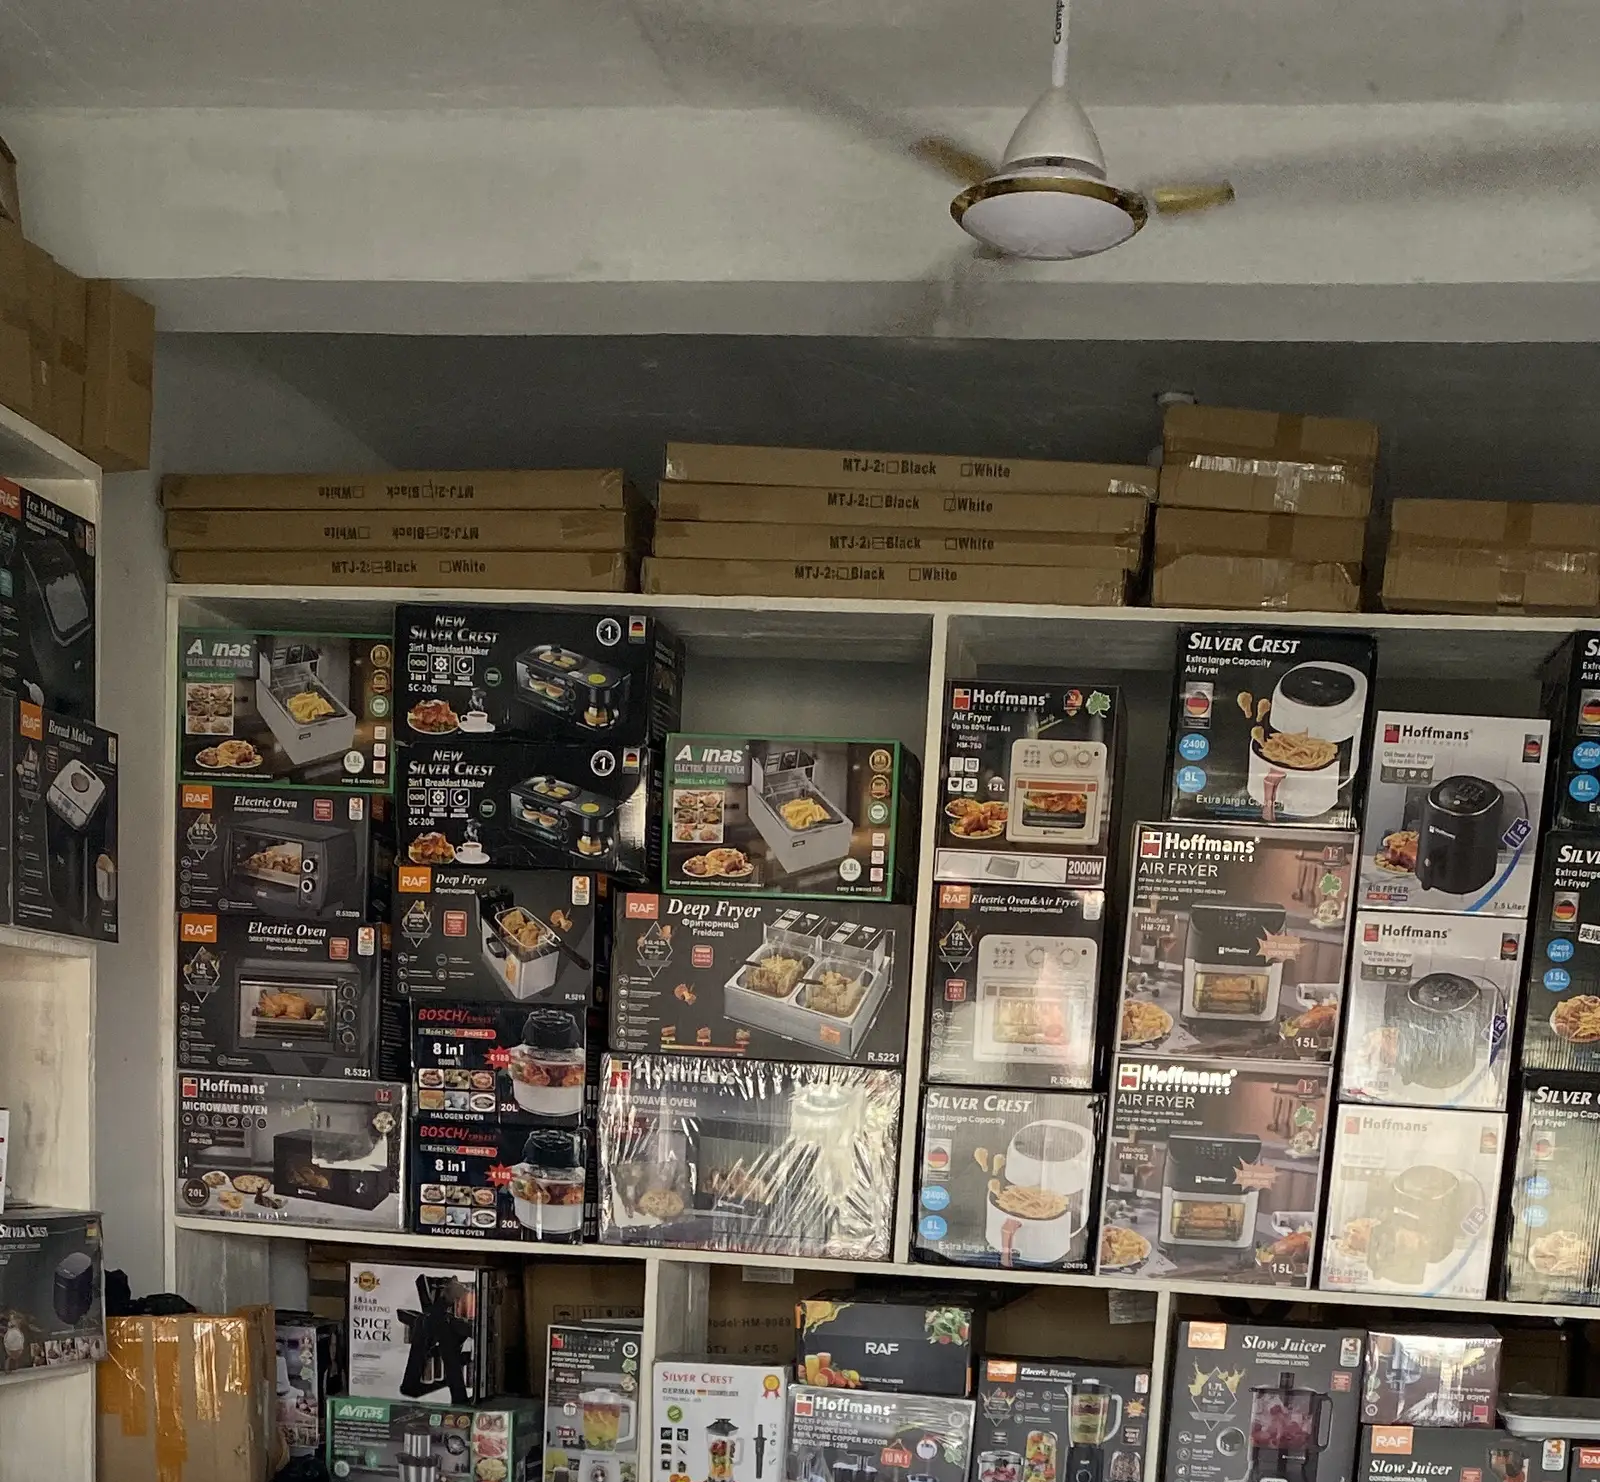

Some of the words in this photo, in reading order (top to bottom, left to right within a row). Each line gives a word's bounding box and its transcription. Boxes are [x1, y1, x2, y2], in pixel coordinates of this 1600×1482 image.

[900, 460, 936, 476] Black
[973, 463, 1010, 478] White
[383, 560, 418, 574] Black
[451, 560, 486, 574] White
[435, 615, 466, 627] NEW
[409, 625, 452, 642] SILVER
[457, 626, 499, 643] CREST
[409, 643, 424, 652] 3in1
[427, 644, 463, 655] Breakfast
[464, 645, 489, 656] Maker
[1188, 632, 1243, 652] SILVER
[1248, 635, 1300, 654] CREST
[1186, 654, 1207, 664] Extra
[1208, 656, 1231, 666] large
[1232, 657, 1271, 668] Capacity
[1185, 666, 1197, 674] Air
[1198, 666, 1219, 676] Fryer
[973, 689, 1046, 707] Hoffmans
[21, 713, 41, 730] RAF
[952, 712, 966, 722] Air
[967, 714, 992, 724] Fryer
[48, 719, 71, 740] Bread
[71, 727, 95, 747] Maker
[1402, 725, 1470, 741] Hoffmans
[1183, 740, 1205, 750] 2400
[408, 760, 451, 776] SILVER
[454, 762, 495, 777] CREST
[987, 783, 1005, 792] 12L
[185, 793, 210, 803] RAF
[234, 795, 271, 808] Electric
[273, 797, 298, 809] Oven
[1165, 833, 1255, 854] Hoffmans
[1164, 851, 1254, 863] ELECTRONICS
[1067, 861, 1102, 876] 2000W
[1139, 862, 1164, 875] AIR
[1168, 863, 1218, 877] FRYER
[401, 876, 428, 887] RAF
[435, 873, 460, 885] Deep
[462, 875, 488, 886] Fryer
[942, 894, 967, 904] RAF
[971, 895, 1006, 905] Electric
[1055, 897, 1079, 907] Fryer
[629, 902, 656, 914] RAF
[667, 899, 711, 918] Deep
[715, 901, 762, 919] Fryer
[184, 924, 213, 936] RAF
[248, 921, 294, 936] Electric
[296, 924, 327, 937] Oven
[1382, 924, 1448, 939] Hoffmans
[1295, 1037, 1318, 1049] 15L
[867, 1051, 900, 1063] R.5221
[344, 1067, 371, 1077] R.5321
[1143, 1065, 1232, 1087] Hoffmans
[200, 1079, 265, 1094] Hoffmans
[927, 1092, 979, 1111] SILVER
[983, 1095, 1032, 1113] CREST
[1534, 1086, 1592, 1105] SILVER
[182, 1101, 240, 1114] MICROWAVE
[242, 1105, 268, 1115] OVEN
[500, 1103, 518, 1113] 20L
[430, 1112, 464, 1121] HALOGEN
[465, 1113, 484, 1121] OVEN
[1362, 1117, 1428, 1132] Hoffmans
[188, 1188, 205, 1198] 20L
[353, 1317, 391, 1331] SPICE
[353, 1328, 392, 1342] RACK
[865, 1342, 899, 1355] RAF
[1242, 1335, 1278, 1350] Slow
[1281, 1338, 1326, 1353] Juicer
[662, 1371, 696, 1382] SILVER
[701, 1373, 733, 1385] CREST
[815, 1397, 891, 1416] Hoffmans
[1376, 1435, 1408, 1447] RAF
[1369, 1459, 1405, 1474] Slow
[1408, 1461, 1452, 1476] Juicer
